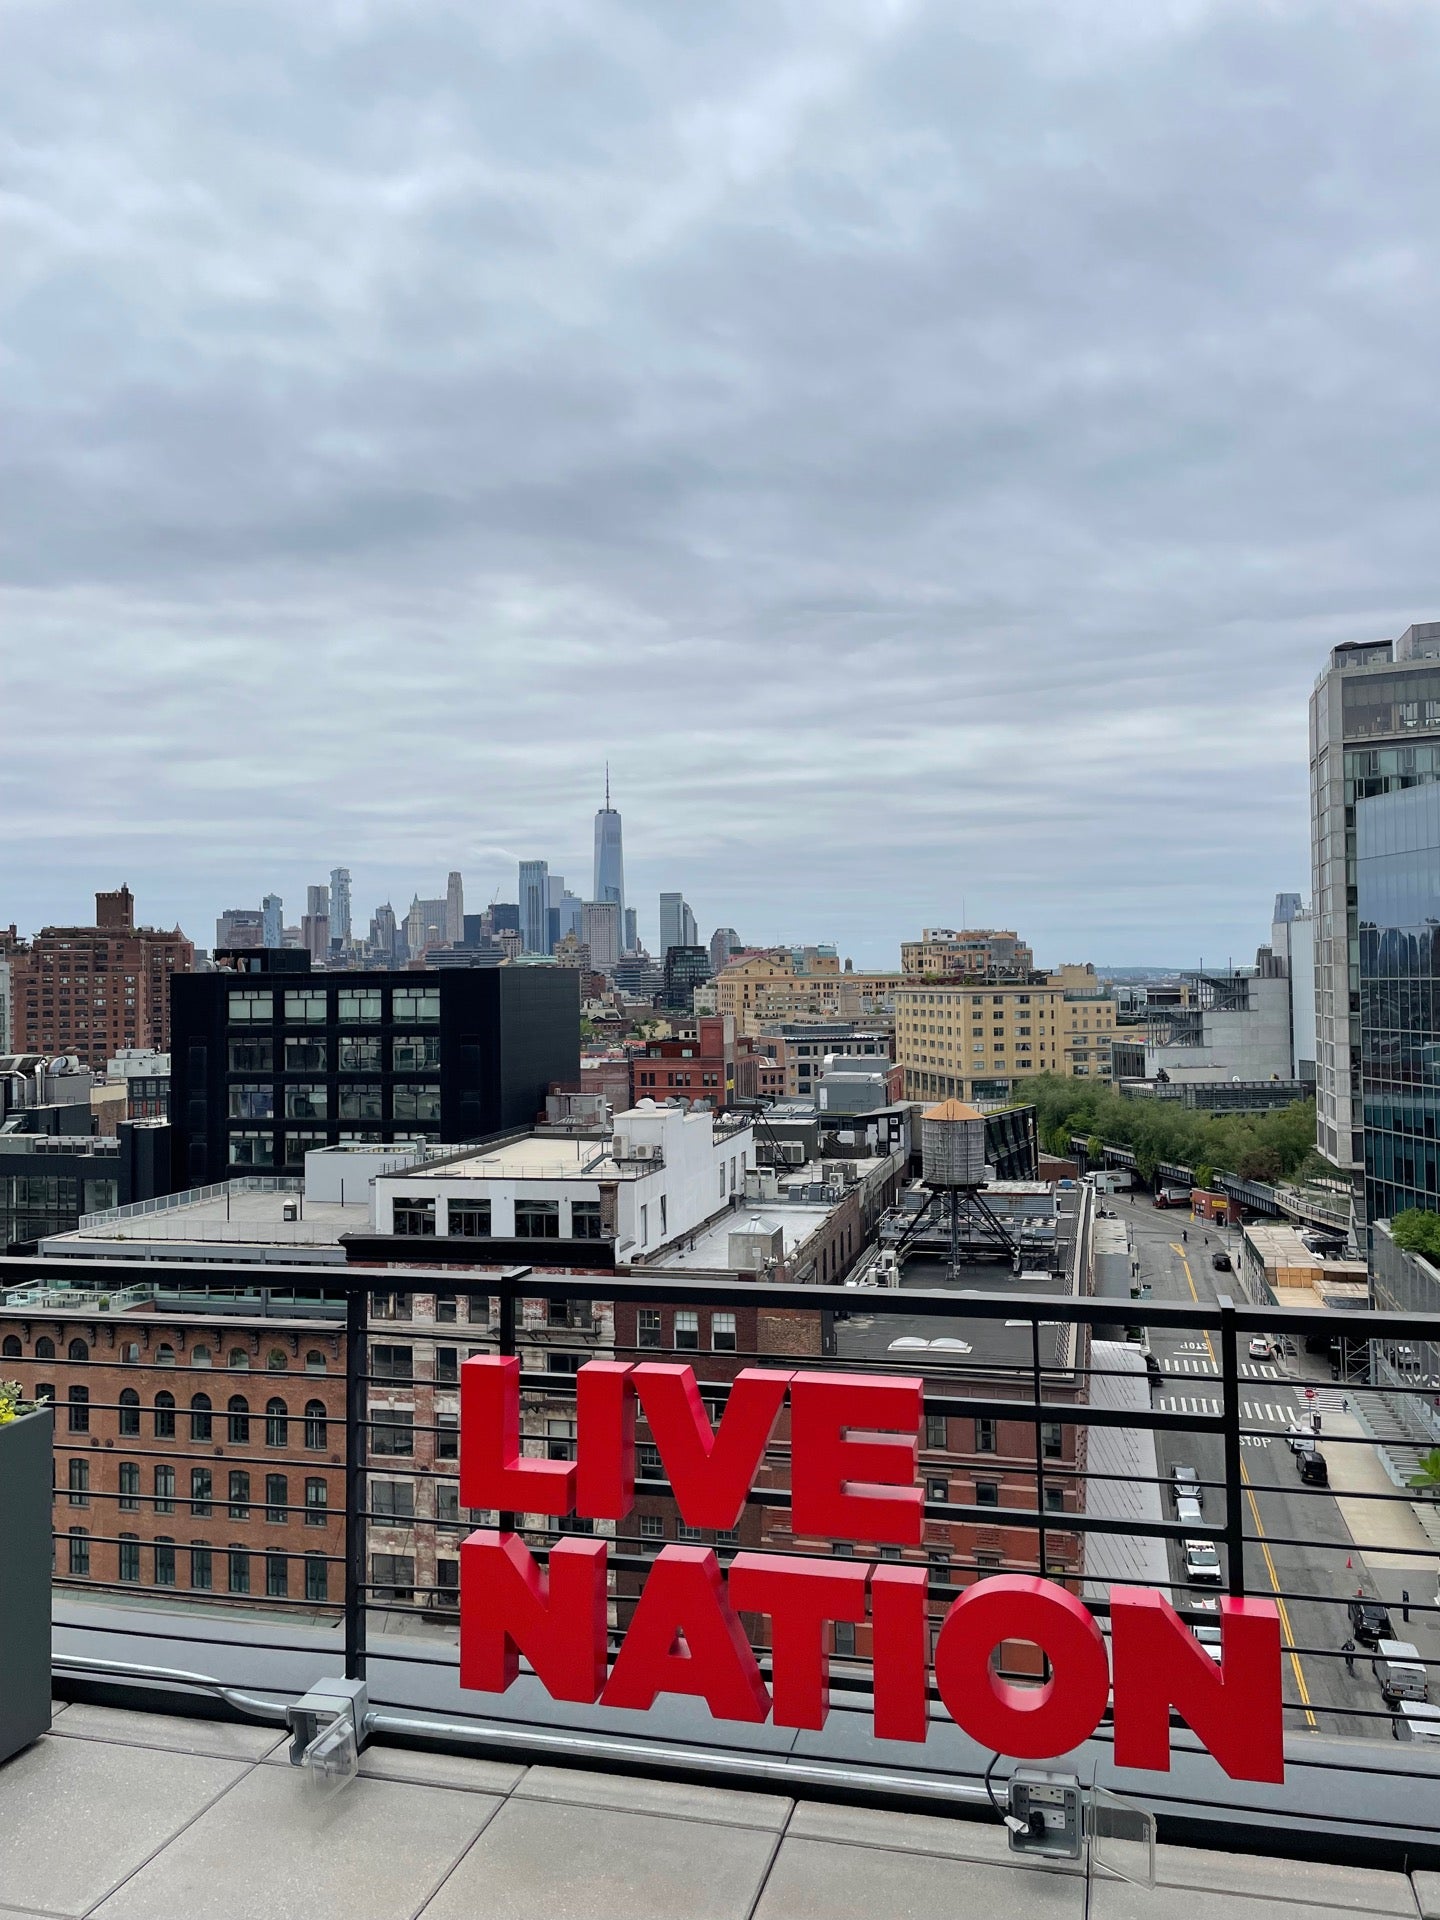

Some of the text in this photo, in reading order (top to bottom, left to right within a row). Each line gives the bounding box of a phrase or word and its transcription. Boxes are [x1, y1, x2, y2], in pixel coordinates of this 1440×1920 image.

[1180, 1341, 1208, 1350] STOP
[460, 1355, 925, 1545] LIVE
[1239, 1435, 1271, 1448] STOP
[460, 1530, 1284, 1784] NATION
